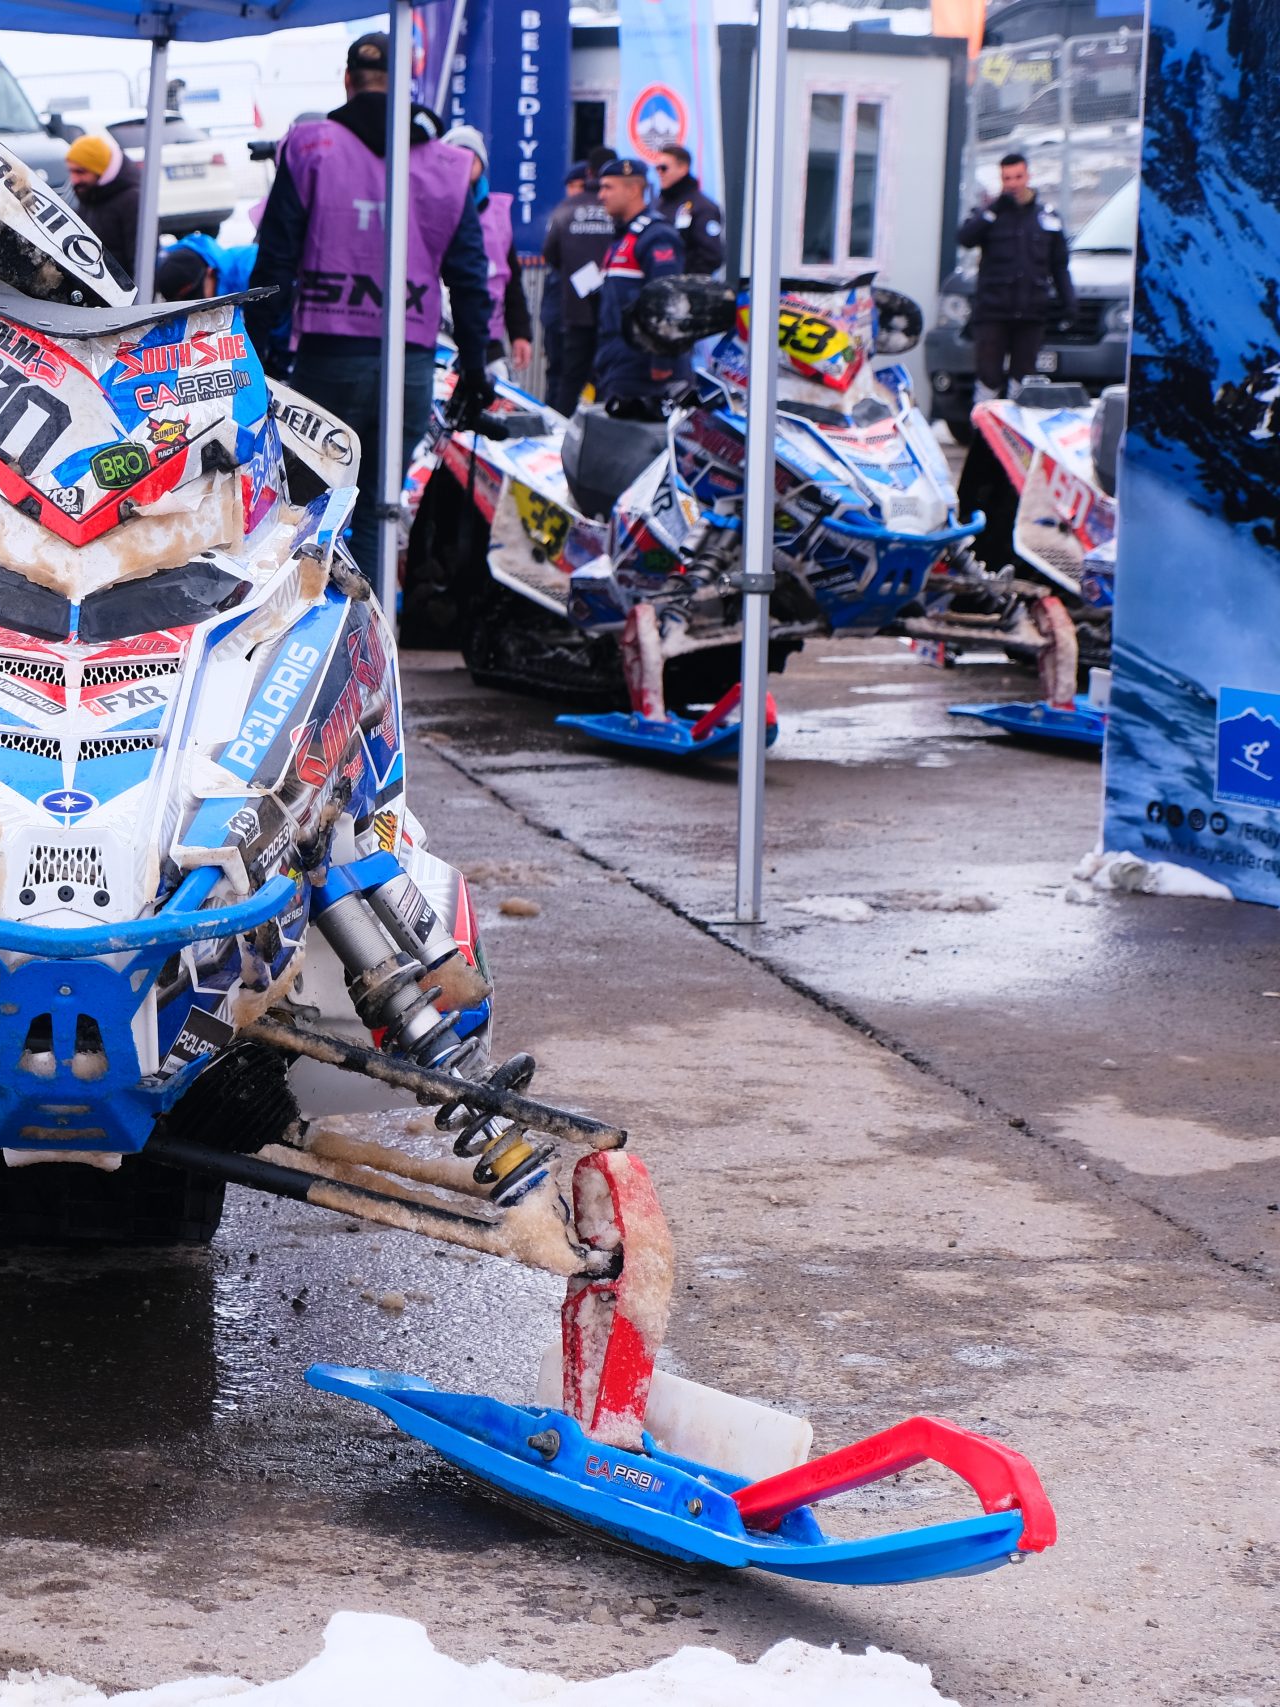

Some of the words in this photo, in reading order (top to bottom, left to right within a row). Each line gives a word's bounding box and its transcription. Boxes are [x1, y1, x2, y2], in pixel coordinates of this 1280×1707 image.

[153, 423, 184, 442] SUNOCO
[99, 451, 144, 482] BRO
[96, 685, 169, 714] FXR
[226, 640, 320, 770] POLARIS
[613, 1464, 654, 1488] PRO
